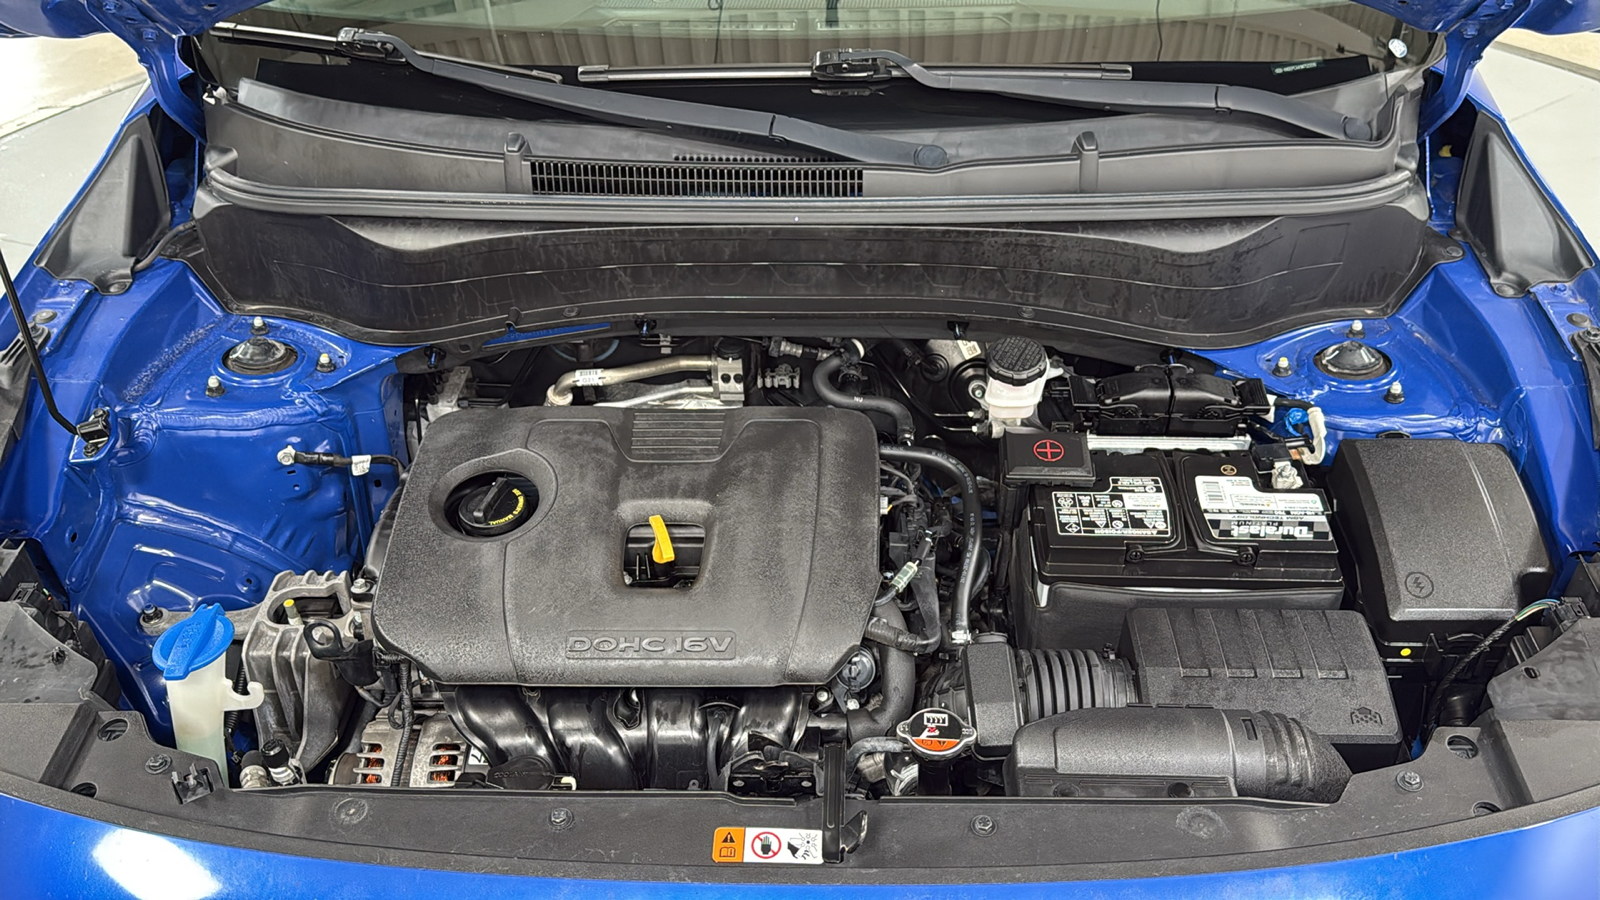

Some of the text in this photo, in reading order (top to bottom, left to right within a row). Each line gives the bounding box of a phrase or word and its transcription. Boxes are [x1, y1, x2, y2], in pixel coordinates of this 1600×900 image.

[1230, 525, 1314, 538] Duralast
[568, 636, 734, 653] DOHC 16V
